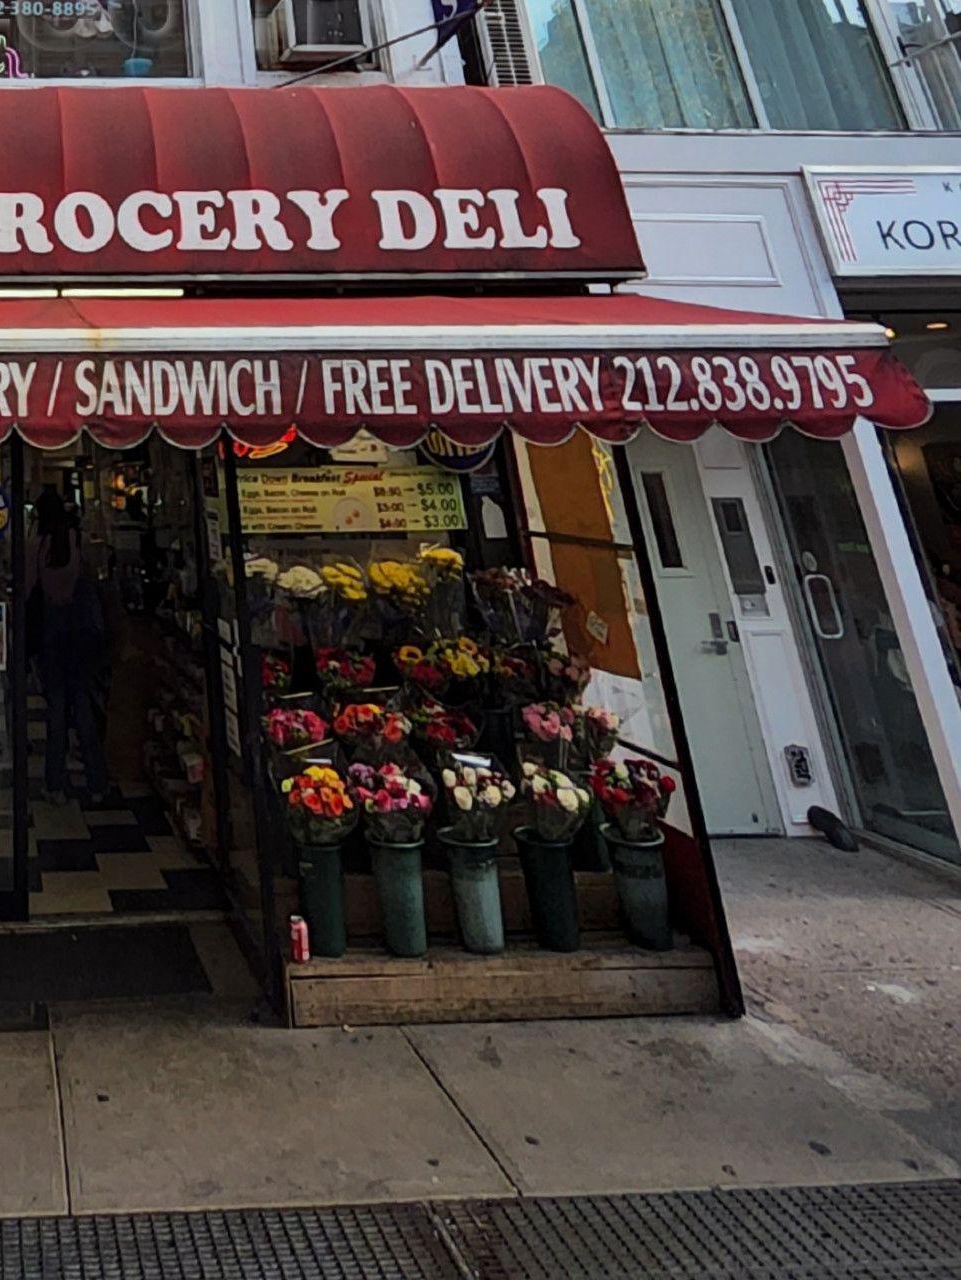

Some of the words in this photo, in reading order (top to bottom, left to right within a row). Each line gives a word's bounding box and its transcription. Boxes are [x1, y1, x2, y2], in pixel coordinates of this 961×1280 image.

[371, 187, 581, 250] DELI
[74, 359, 282, 416] SANDWICH
[321, 359, 418, 416] FREE
[424, 356, 603, 415] DELIVERY
[612, 355, 875, 411] 212.838.9795
[238, 474, 258, 483] rice
[291, 472, 340, 483] Breakfast
[343, 471, 385, 485] Special
[417, 482, 454, 497] $5.00
[420, 498, 457, 512] $4.00
[423, 514, 460, 528] $3.00
